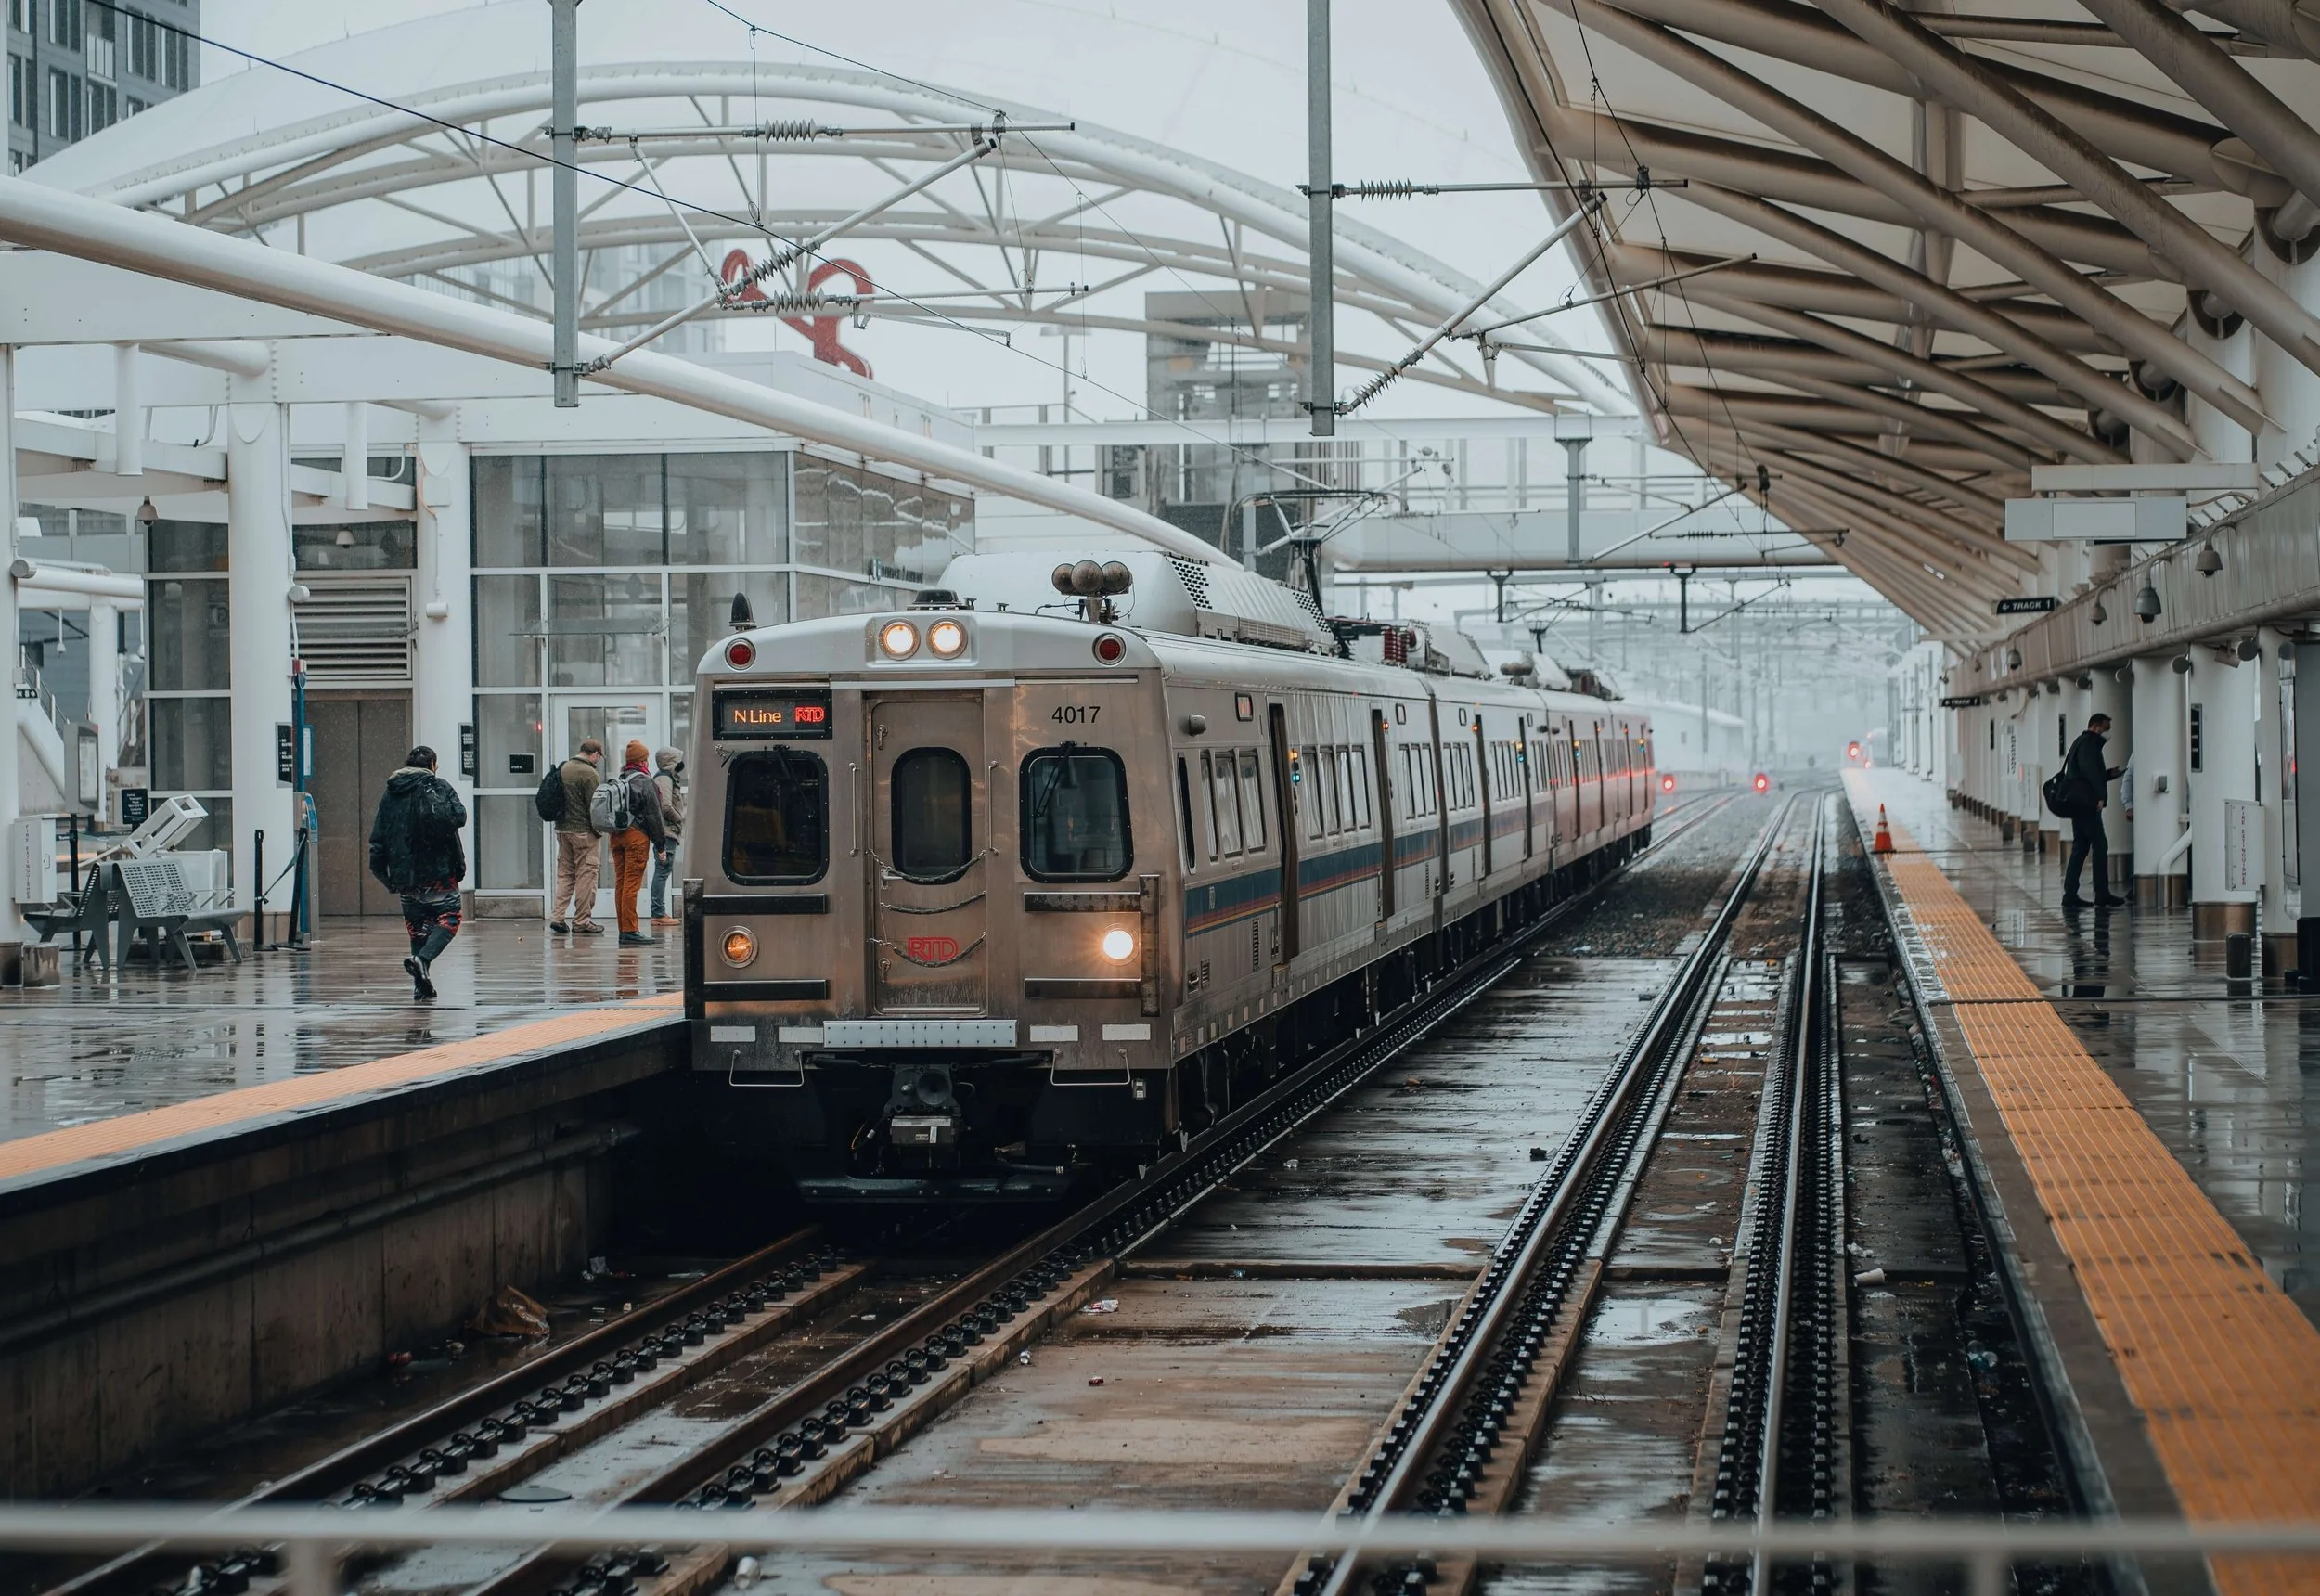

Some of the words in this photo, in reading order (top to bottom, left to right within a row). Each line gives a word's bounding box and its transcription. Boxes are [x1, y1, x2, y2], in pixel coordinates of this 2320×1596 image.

[2012, 601, 2042, 611] TRACK
[2045, 599, 2051, 609] 1
[734, 710, 746, 723] N
[750, 709, 781, 723] Line
[795, 706, 824, 722] RTD
[1051, 706, 1101, 724] 4017
[908, 937, 959, 961] RTD
